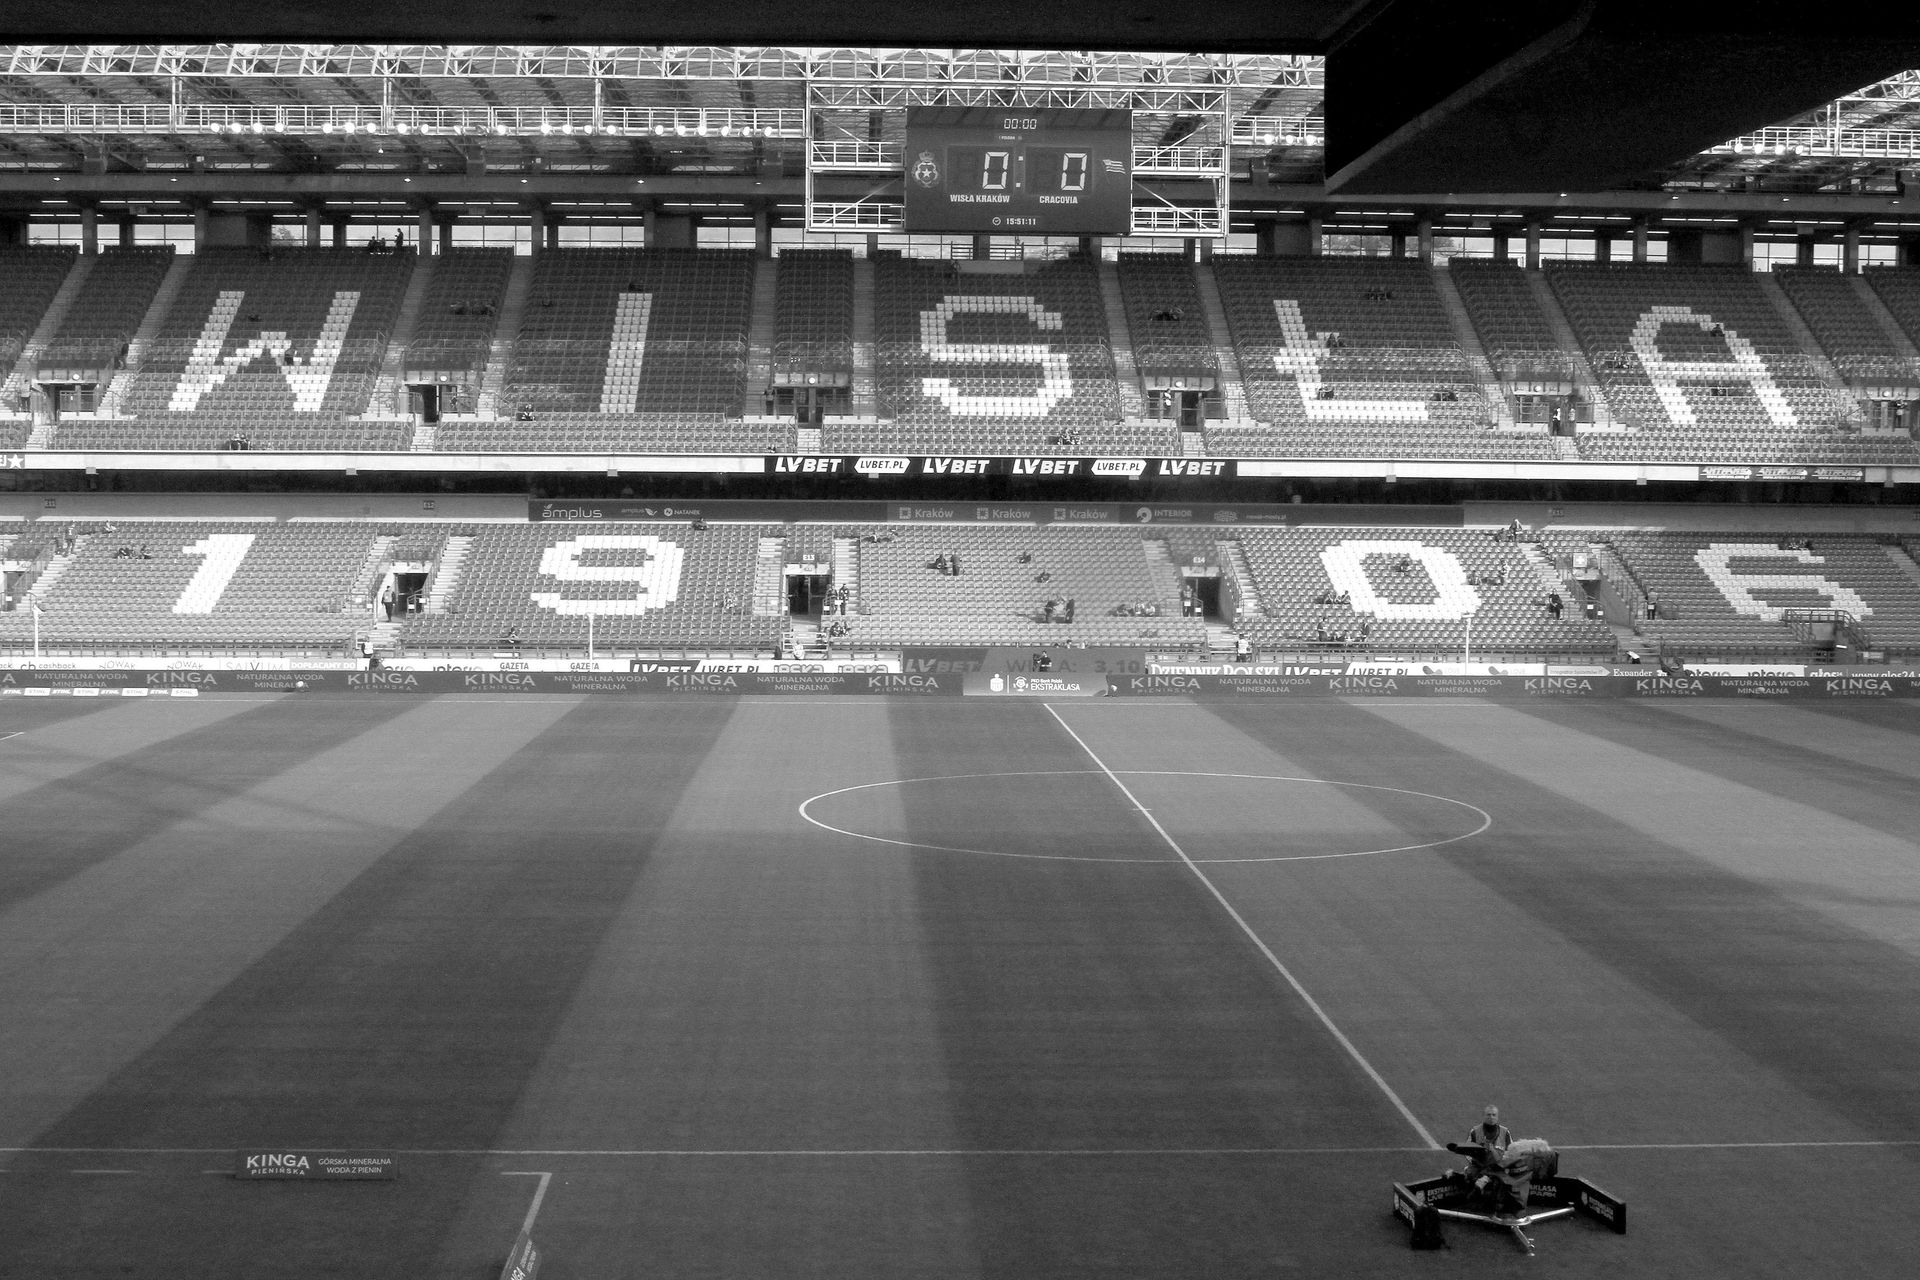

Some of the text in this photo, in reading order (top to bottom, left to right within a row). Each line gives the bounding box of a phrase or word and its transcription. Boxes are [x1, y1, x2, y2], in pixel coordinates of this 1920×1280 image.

[1004, 119, 1037, 129] 00:00
[983, 152, 1009, 189] 0
[1061, 153, 1087, 190] 0
[950, 193, 1010, 203] WISŁA KRAKÓW
[1040, 196, 1078, 204] CRACOVIA
[775, 457, 1225, 475] LVBET LVBET.PL LVBET LVBET LVBET.PL LVBET
[915, 508, 954, 519] Kraków
[992, 508, 1031, 519] Kraków
[1070, 509, 1108, 520] Kraków
[500, 662, 529, 670] GAZETA
[702, 665, 760, 673] LVBETPL
[905, 659, 979, 672] LVBET
[1006, 660, 1077, 672] WIA:
[1353, 668, 1408, 676] LVBETPL
[146, 672, 217, 685] KINGA
[347, 673, 418, 685] KINGA
[465, 673, 536, 686] KINGA
[666, 674, 738, 687] KINGA
[868, 675, 939, 688] KINGA
[1131, 676, 1201, 689] KINGA
[1329, 677, 1398, 689] KINGA
[1524, 678, 1592, 690] KINGA
[1636, 678, 1704, 691] KINGA
[1030, 683, 1080, 691] EKSTRAKLASA
[1826, 679, 1893, 691] KINGA
[246, 1154, 310, 1169] KINGA
[318, 1157, 347, 1165] GÓRSKA
[251, 1166, 305, 1175] PIENIŃSKA
